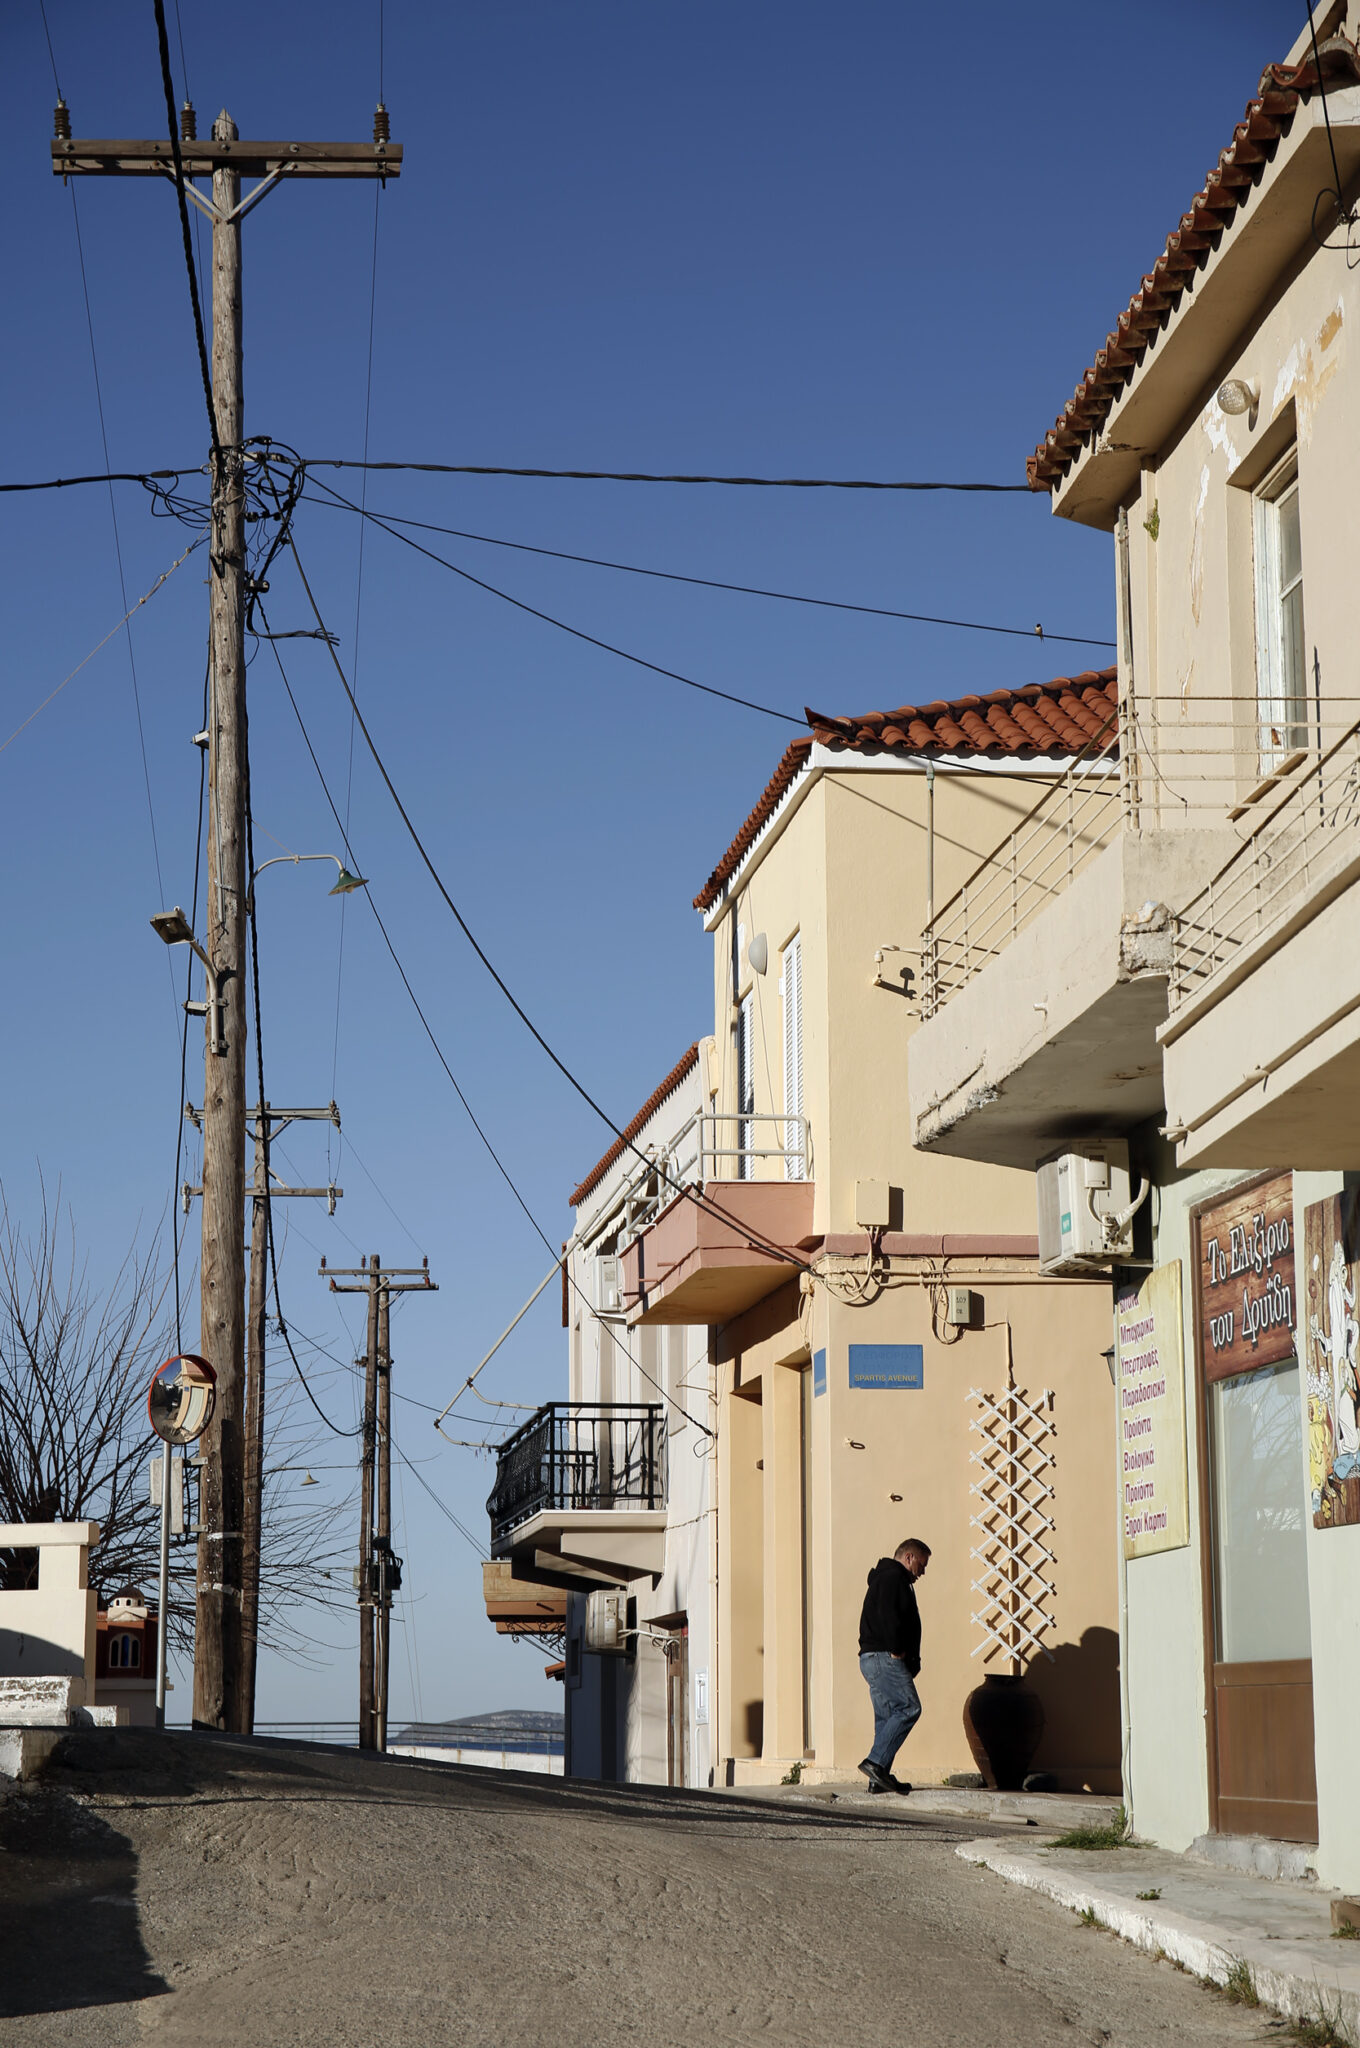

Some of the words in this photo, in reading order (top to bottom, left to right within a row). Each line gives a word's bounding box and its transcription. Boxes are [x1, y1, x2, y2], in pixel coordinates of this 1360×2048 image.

[1207, 1237, 1227, 1284] Το
[1229, 1211, 1290, 1275] Ελιξίριο
[1120, 1311, 1155, 1346] Μπαχαρικά
[1210, 1310, 1235, 1348] του
[1120, 1343, 1160, 1377] Υπερτροφές
[1122, 1373, 1166, 1410] Παραδοσιακά
[1123, 1443, 1155, 1472] Βιολογικά
[1125, 1511, 1143, 1540] Ξηροί
[1143, 1505, 1168, 1536] Καρποί
